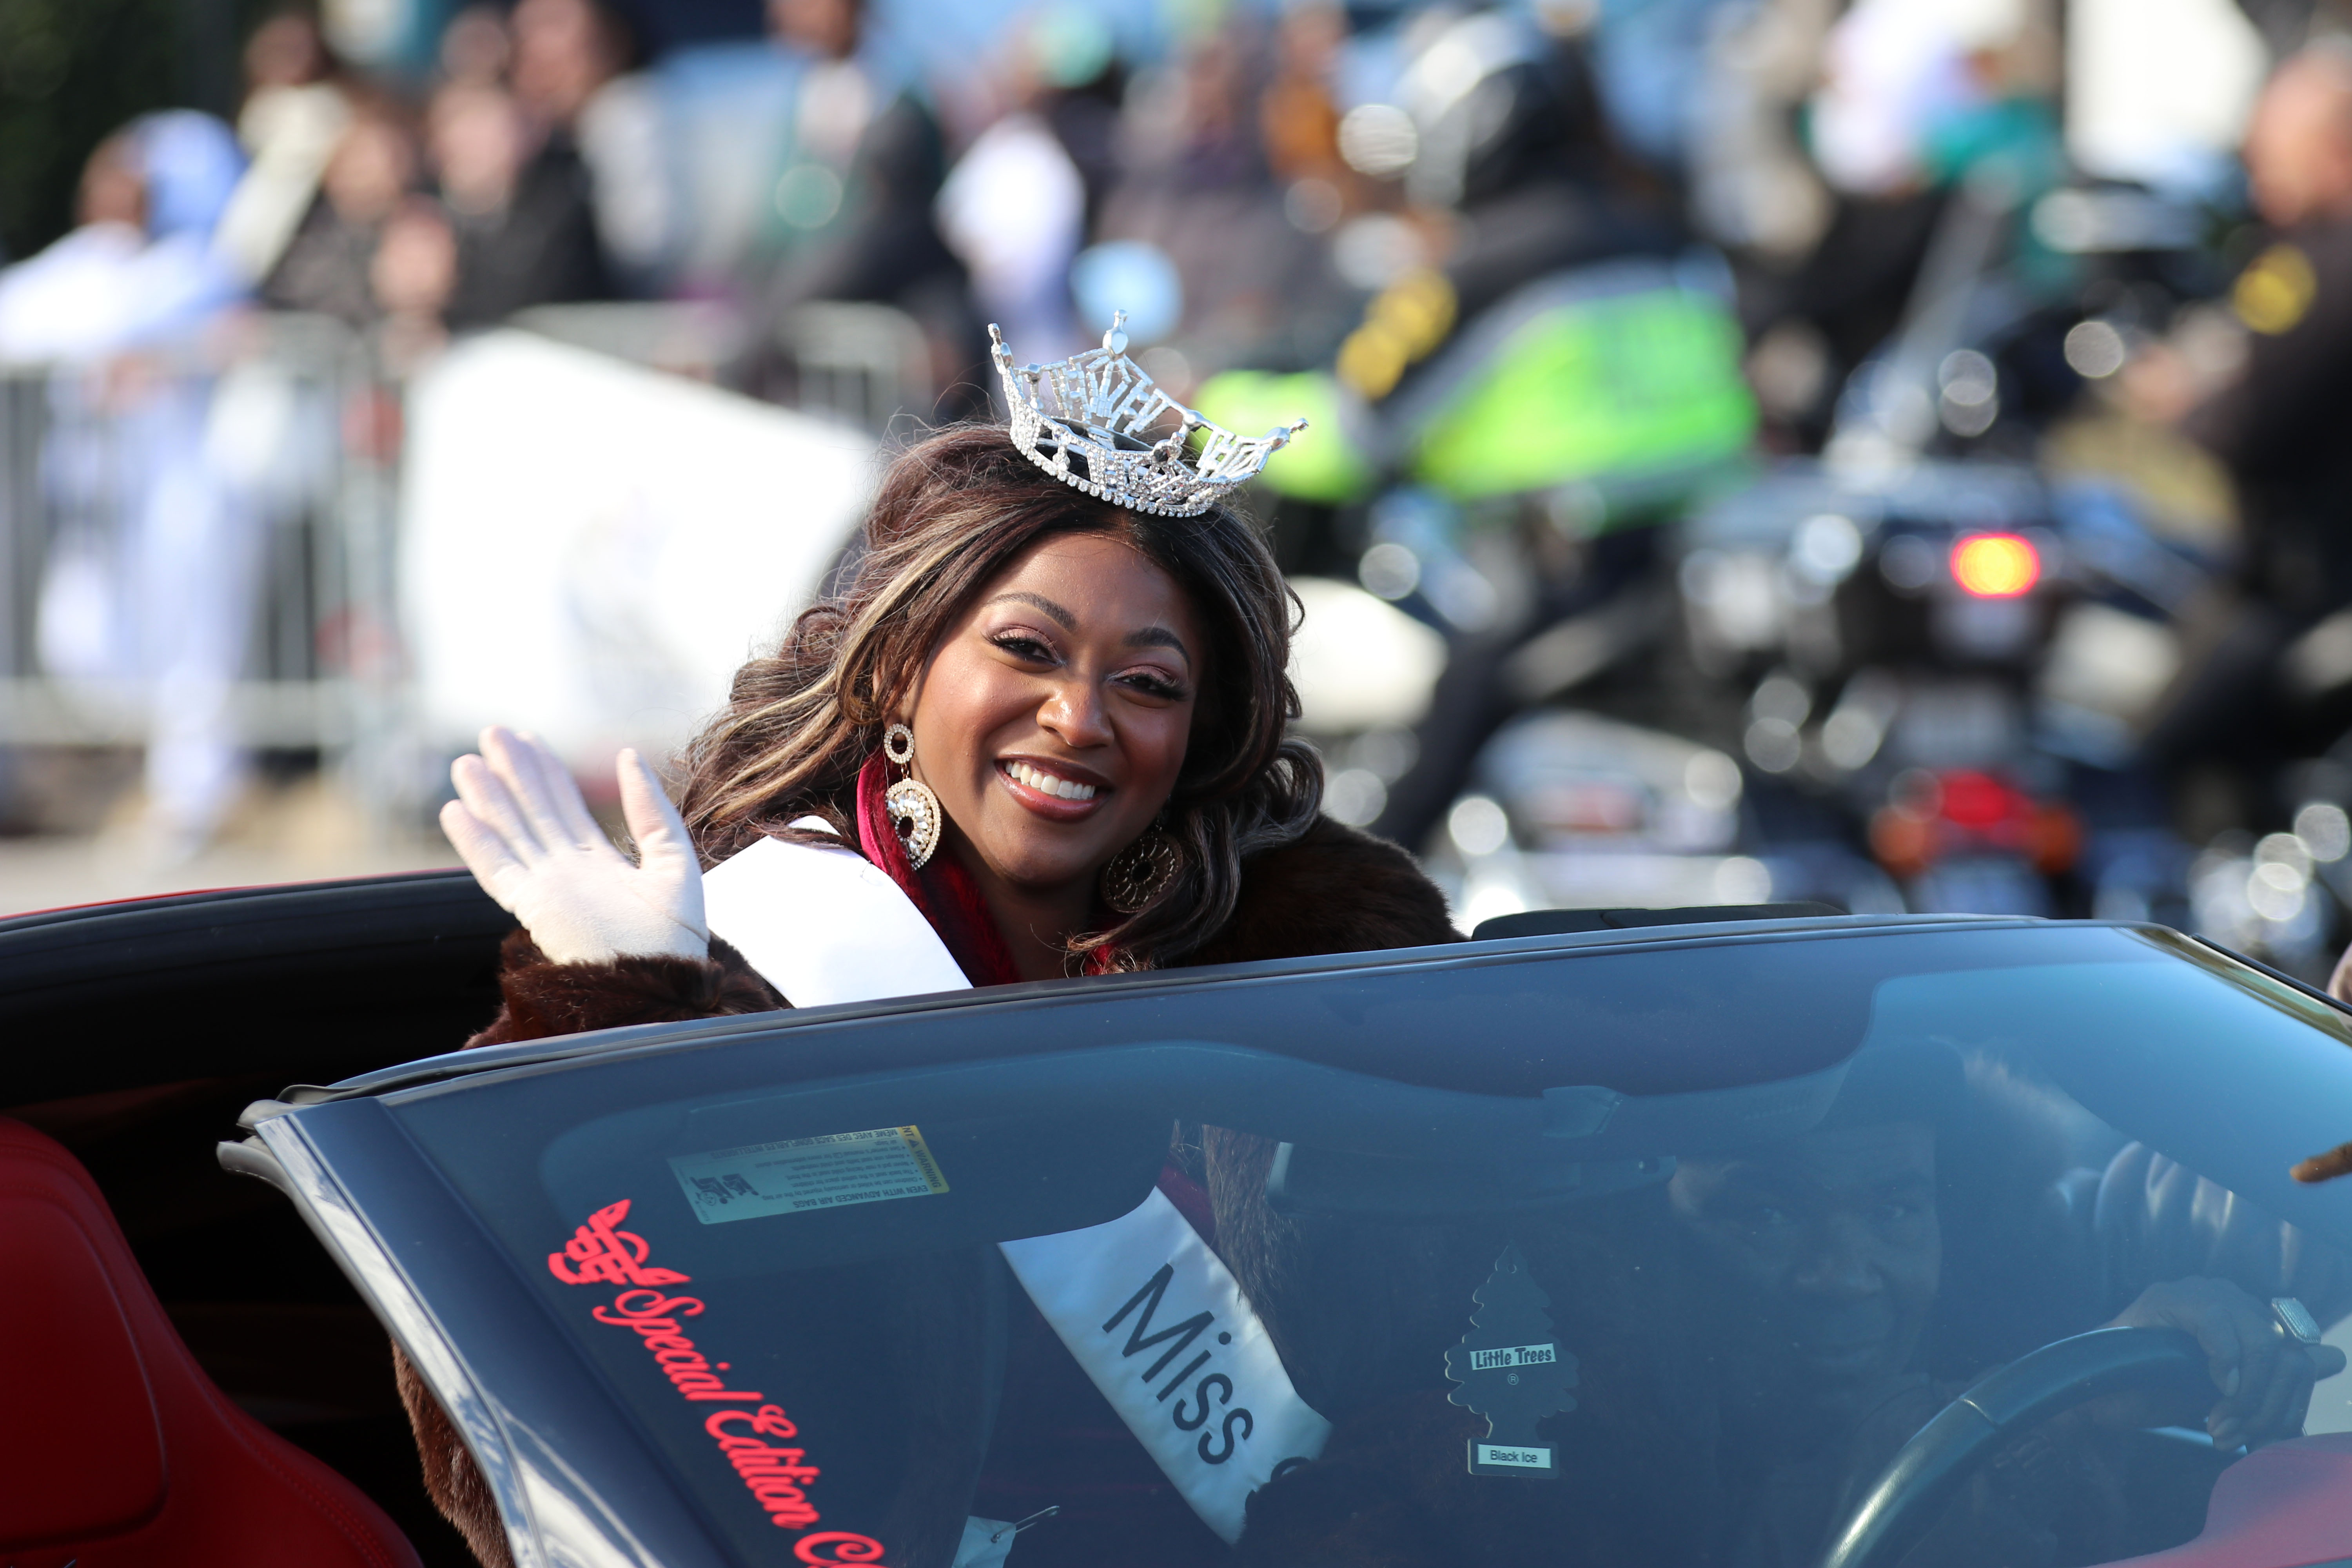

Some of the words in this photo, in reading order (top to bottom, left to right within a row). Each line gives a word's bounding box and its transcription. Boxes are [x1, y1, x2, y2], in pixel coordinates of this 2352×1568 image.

[835, 1133, 853, 1142] DES
[852, 1131, 873, 1140] AVEC
[873, 1128, 899, 1139] MÊME
[814, 1135, 836, 1144] SACS
[915, 1150, 942, 1188] WARNING
[893, 1176, 918, 1184] Children
[881, 1187, 905, 1196] WITH
[905, 1185, 929, 1194] EVEN
[834, 1190, 882, 1202] ADVANCED
[791, 1198, 818, 1208] BAGS
[1475, 1349, 1512, 1368] Little
[1514, 1347, 1552, 1364] Trees
[1102, 1263, 1253, 1465] Miss
[592, 1289, 764, 1401] Special
[705, 1404, 820, 1529] Edition
[1490, 1449, 1519, 1462] Black
[1522, 1452, 1538, 1463] Ice
